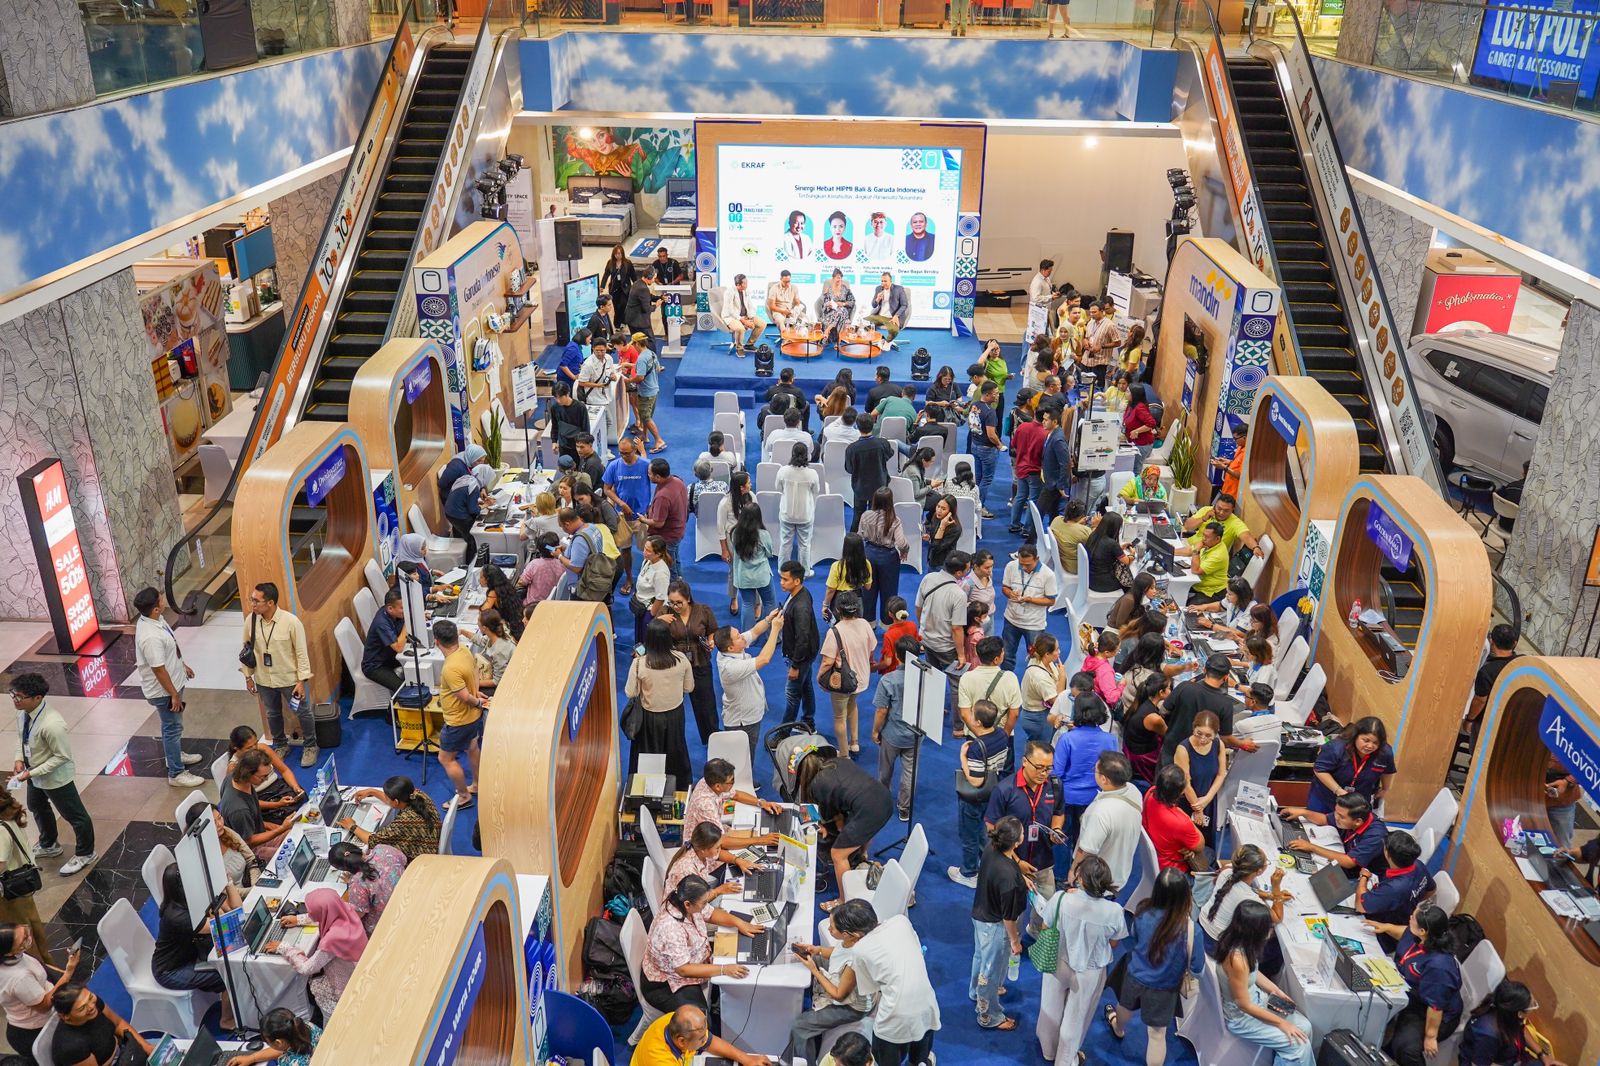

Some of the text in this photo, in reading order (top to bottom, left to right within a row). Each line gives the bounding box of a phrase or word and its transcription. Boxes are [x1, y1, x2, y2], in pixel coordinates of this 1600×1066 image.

[1488, 51, 1581, 80] GADGET & ACCESSORIES
[463, 278, 482, 303] Garuda
[1189, 274, 1220, 320] mandiri
[286, 290, 322, 385] BERBURU DISKON
[55, 544, 80, 569] SALE
[60, 565, 85, 596] 50%
[67, 593, 90, 620] SHOP
[70, 606, 94, 634] NOW!
[1545, 715, 1600, 790] Antavay
[452, 951, 482, 1032] WITA TOUR
